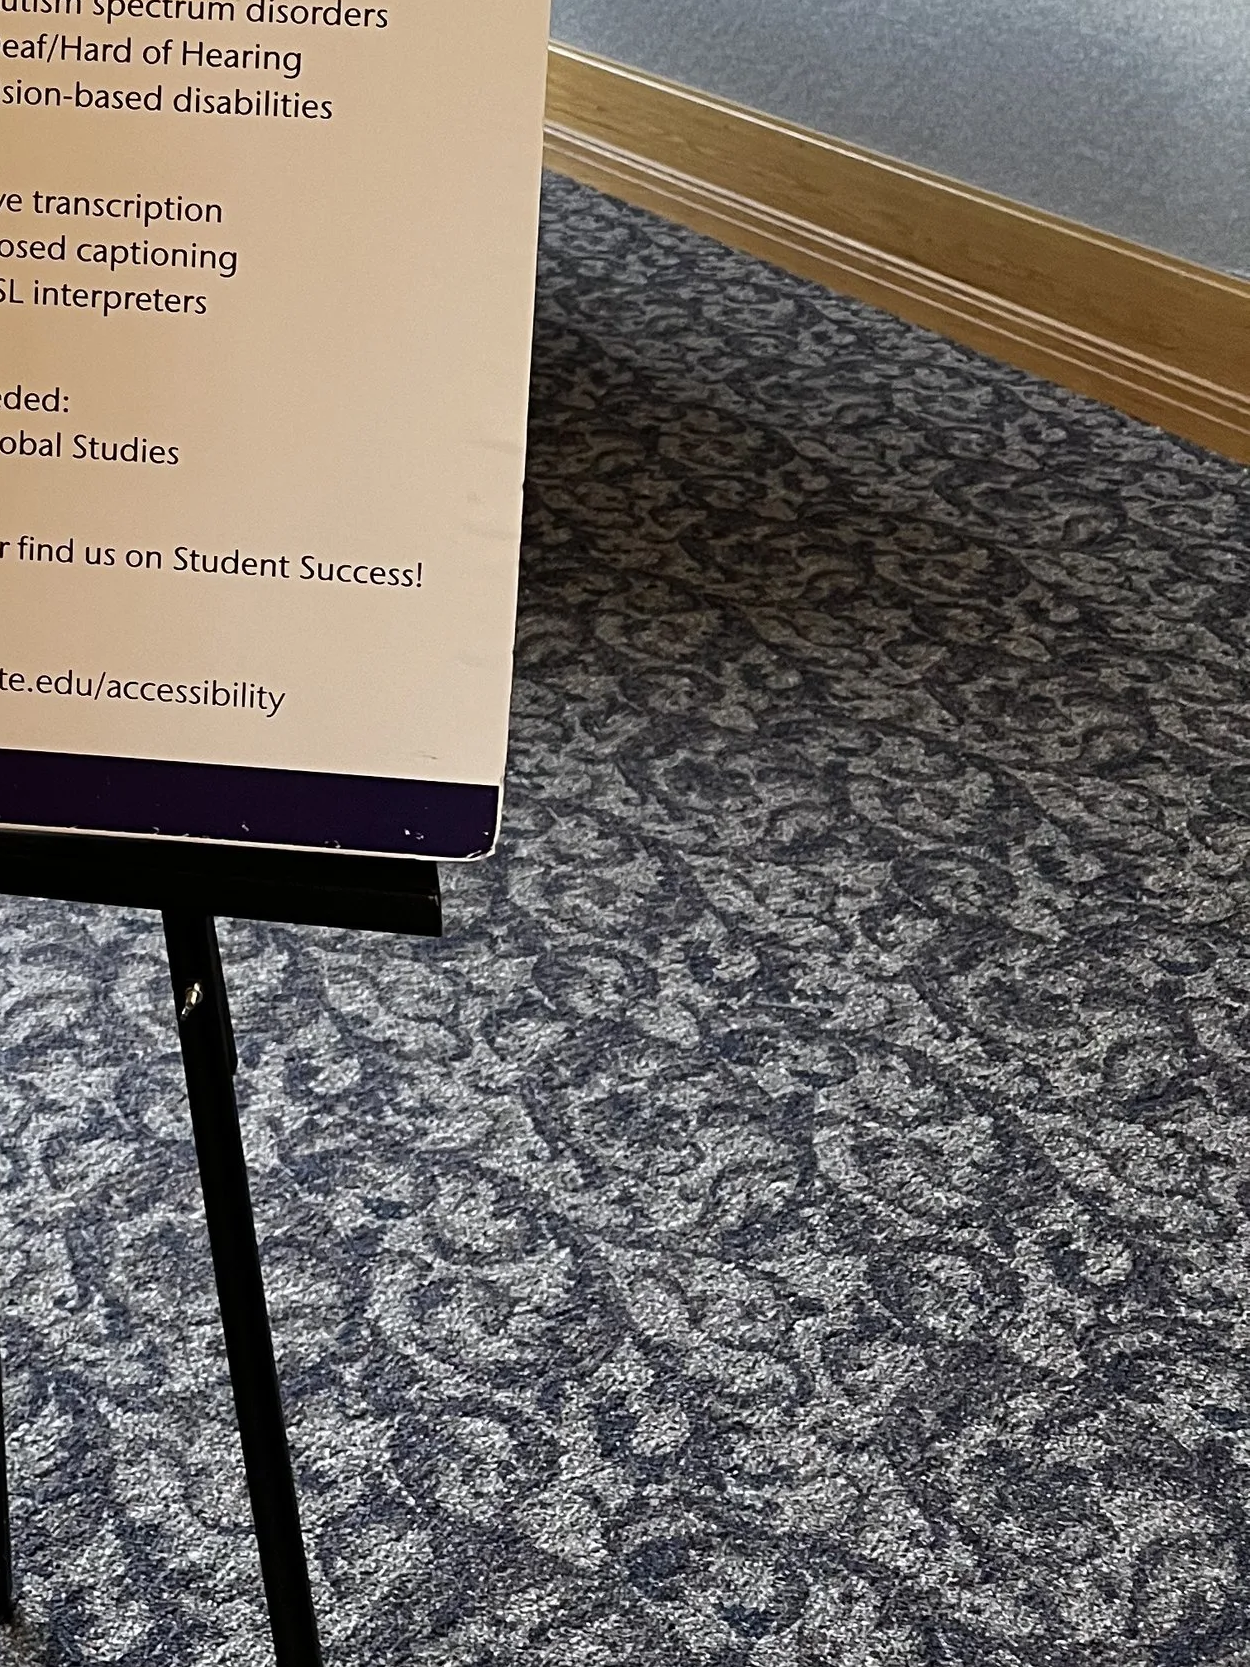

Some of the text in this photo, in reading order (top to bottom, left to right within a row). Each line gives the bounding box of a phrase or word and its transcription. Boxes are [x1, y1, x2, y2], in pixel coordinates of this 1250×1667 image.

[142, 38, 174, 66] of
[182, 40, 302, 80] Hearing
[172, 85, 333, 120] disabilities
[31, 190, 222, 228] transcription
[76, 239, 238, 279] captioning
[33, 279, 207, 318] interpreters
[71, 433, 179, 466] Studies
[16, 535, 74, 564] find
[85, 546, 116, 566] us
[125, 549, 162, 570] on
[172, 546, 291, 579] Student
[299, 555, 423, 588] Success!
